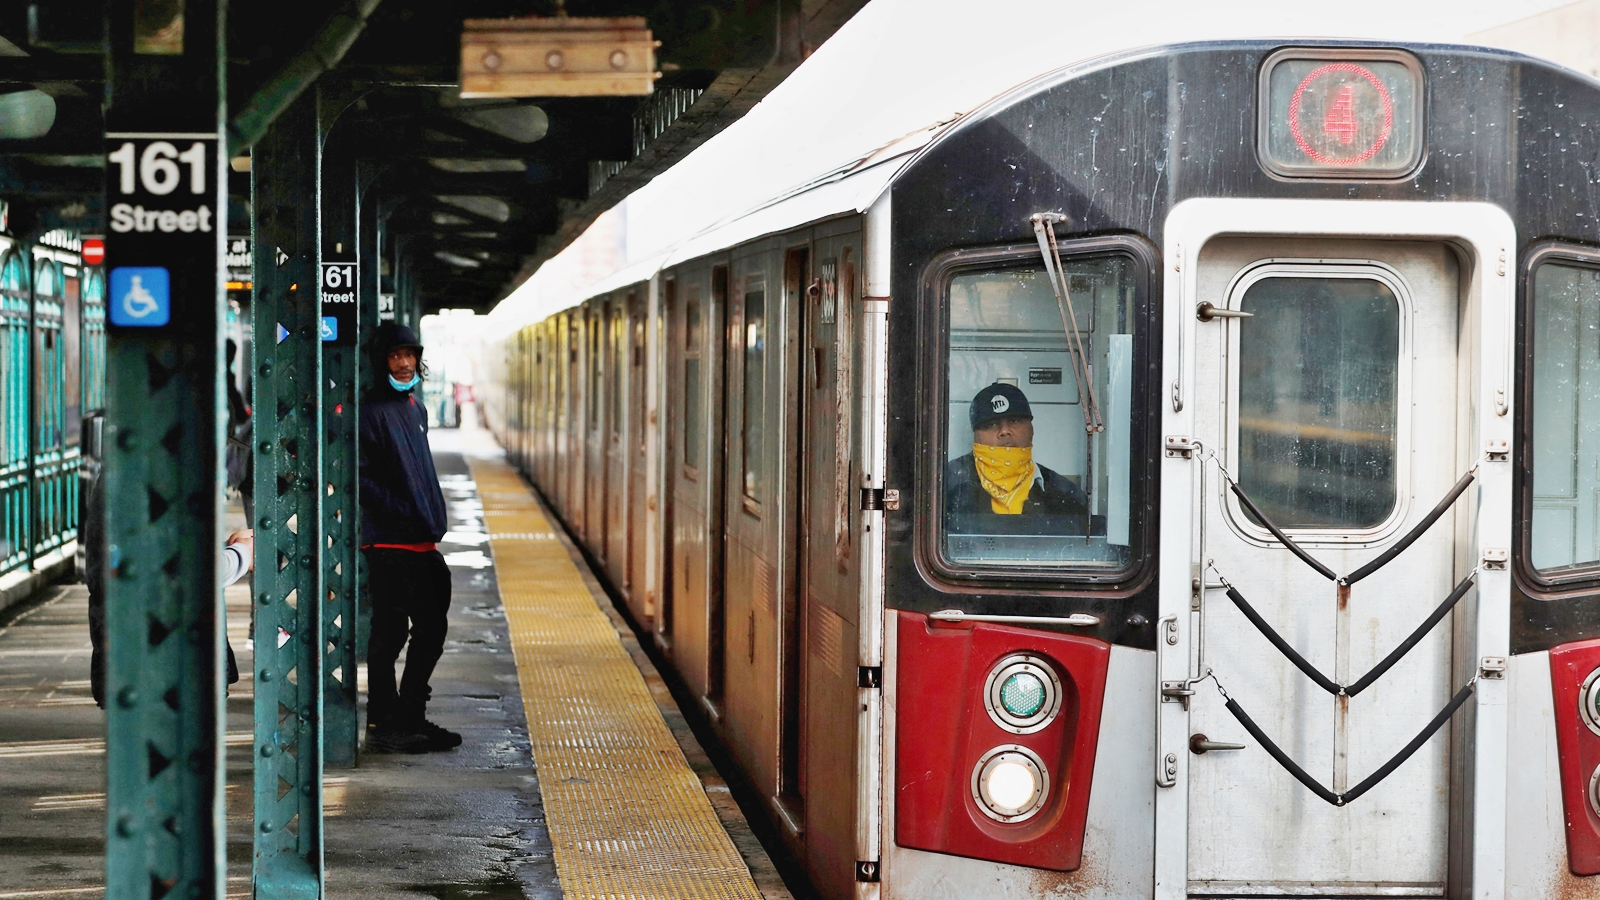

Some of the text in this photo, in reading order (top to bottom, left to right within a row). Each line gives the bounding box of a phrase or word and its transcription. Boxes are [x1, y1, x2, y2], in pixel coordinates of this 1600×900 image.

[1324, 83, 1358, 144] 4
[109, 141, 206, 196] 161
[110, 203, 212, 233] Street
